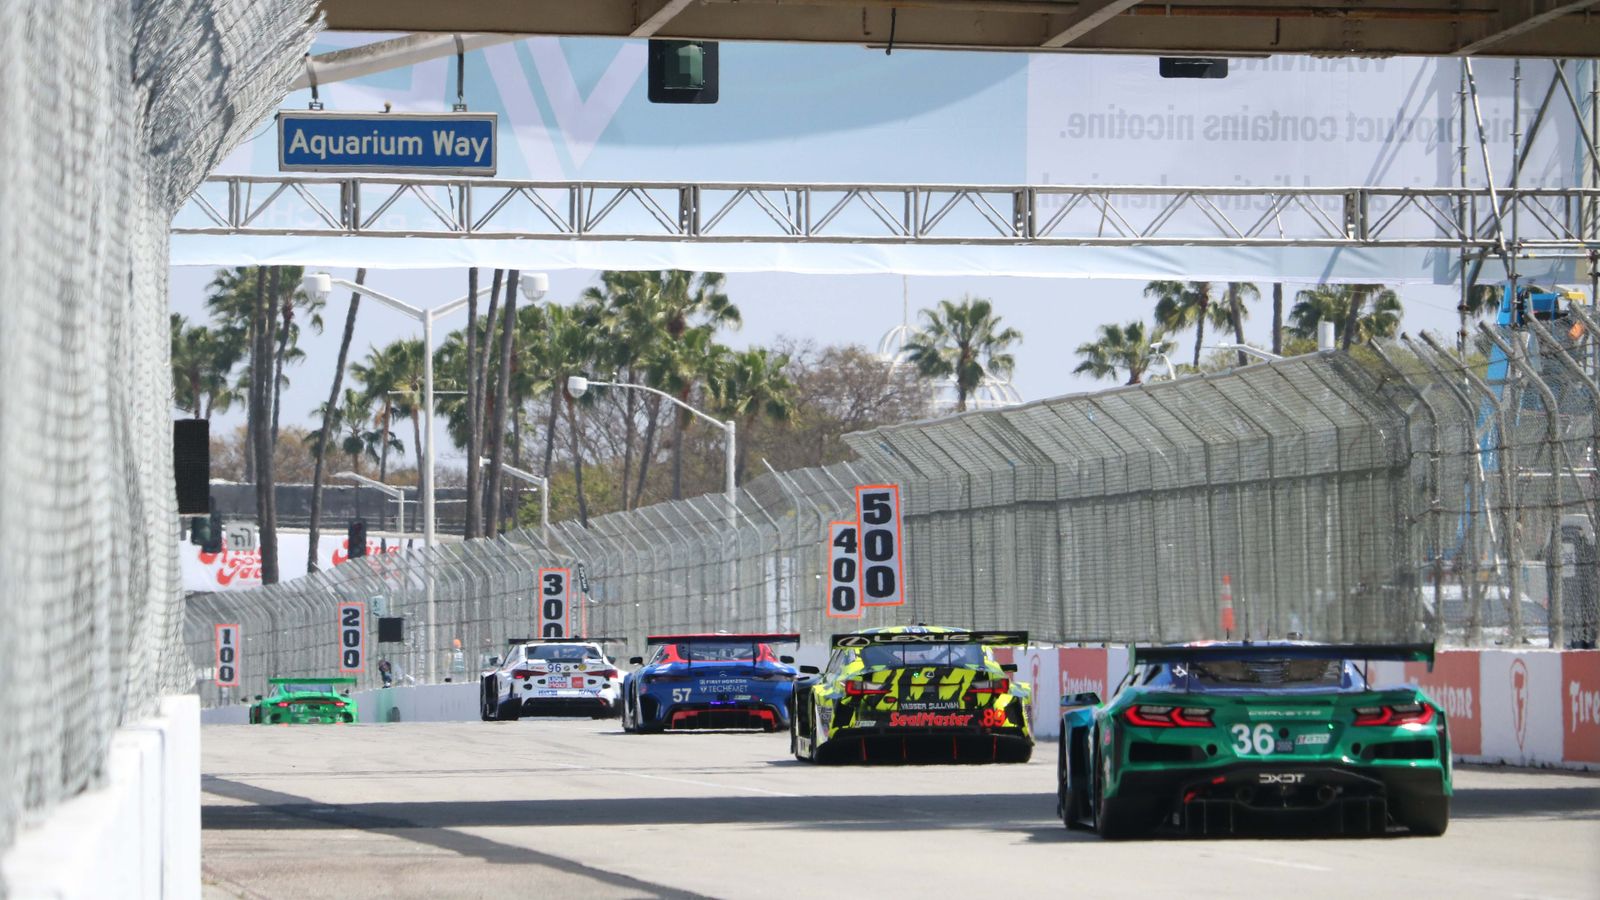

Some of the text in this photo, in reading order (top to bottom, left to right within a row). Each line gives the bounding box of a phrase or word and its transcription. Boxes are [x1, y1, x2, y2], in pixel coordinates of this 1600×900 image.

[288, 128, 489, 163] Aquarium Way
[862, 492, 896, 598] 500
[832, 528, 857, 612] 400
[543, 573, 563, 638] 300
[342, 608, 361, 668] 200
[874, 633, 970, 643] LEXUS
[219, 628, 235, 682] 100
[547, 663, 562, 673] 96
[672, 687, 692, 703] 57
[889, 710, 973, 728] SealMaster
[983, 708, 1006, 728] 89
[1231, 723, 1275, 755] 36
